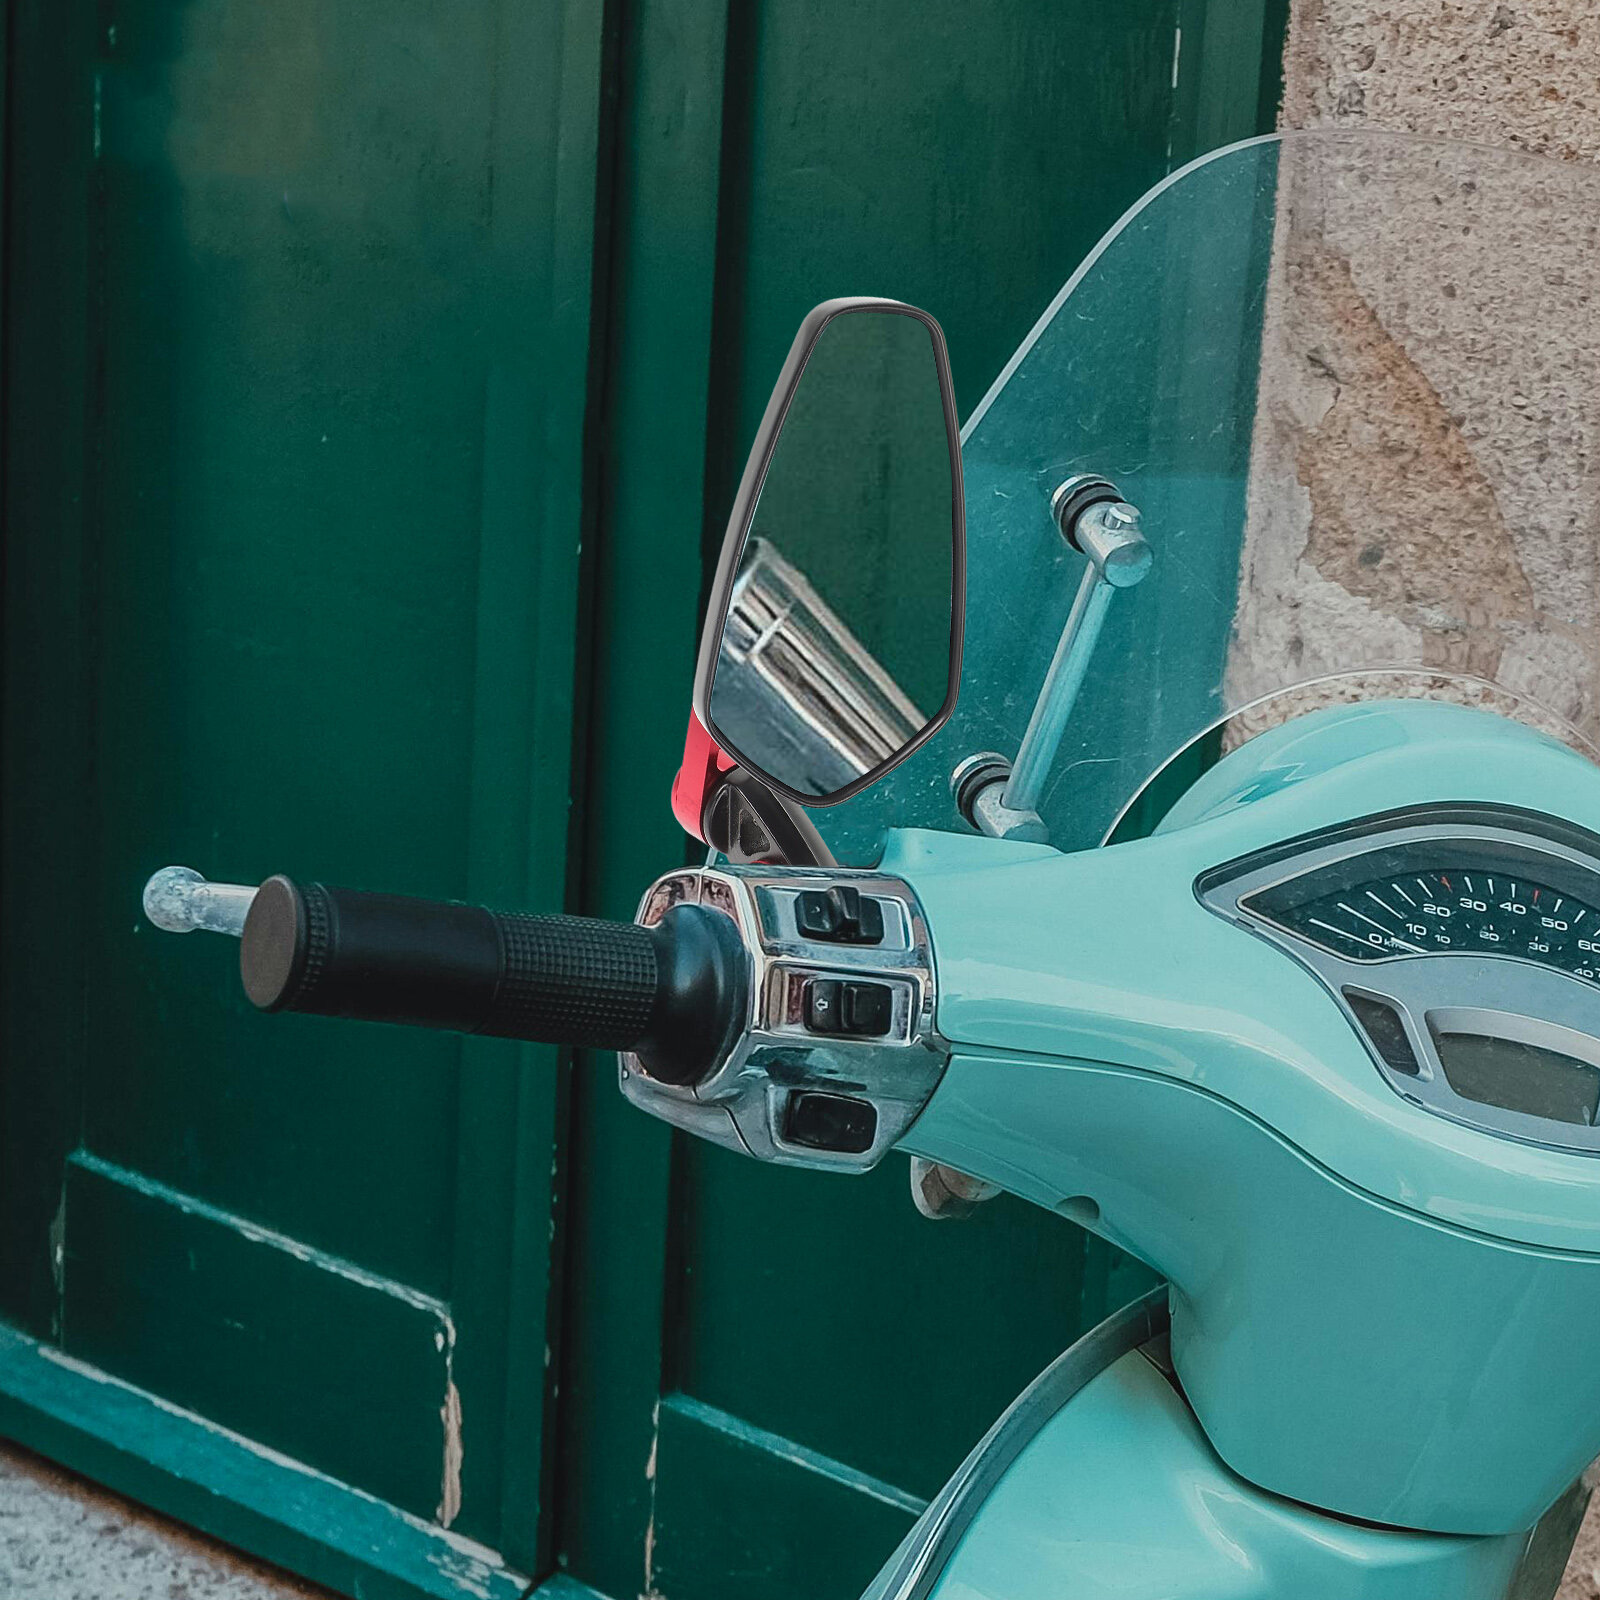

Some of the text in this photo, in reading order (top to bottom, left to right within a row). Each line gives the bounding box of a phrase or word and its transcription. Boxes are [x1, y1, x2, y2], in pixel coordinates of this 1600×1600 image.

[1369, 933, 1382, 944] 0
[1406, 923, 1427, 936] 10
[1423, 903, 1451, 918] 20
[1460, 897, 1487, 912] 30
[1499, 902, 1527, 915] 40
[1541, 917, 1568, 931] 50
[1578, 939, 1600, 953] 60
[1434, 930, 1594, 978] 10 20 30 40
